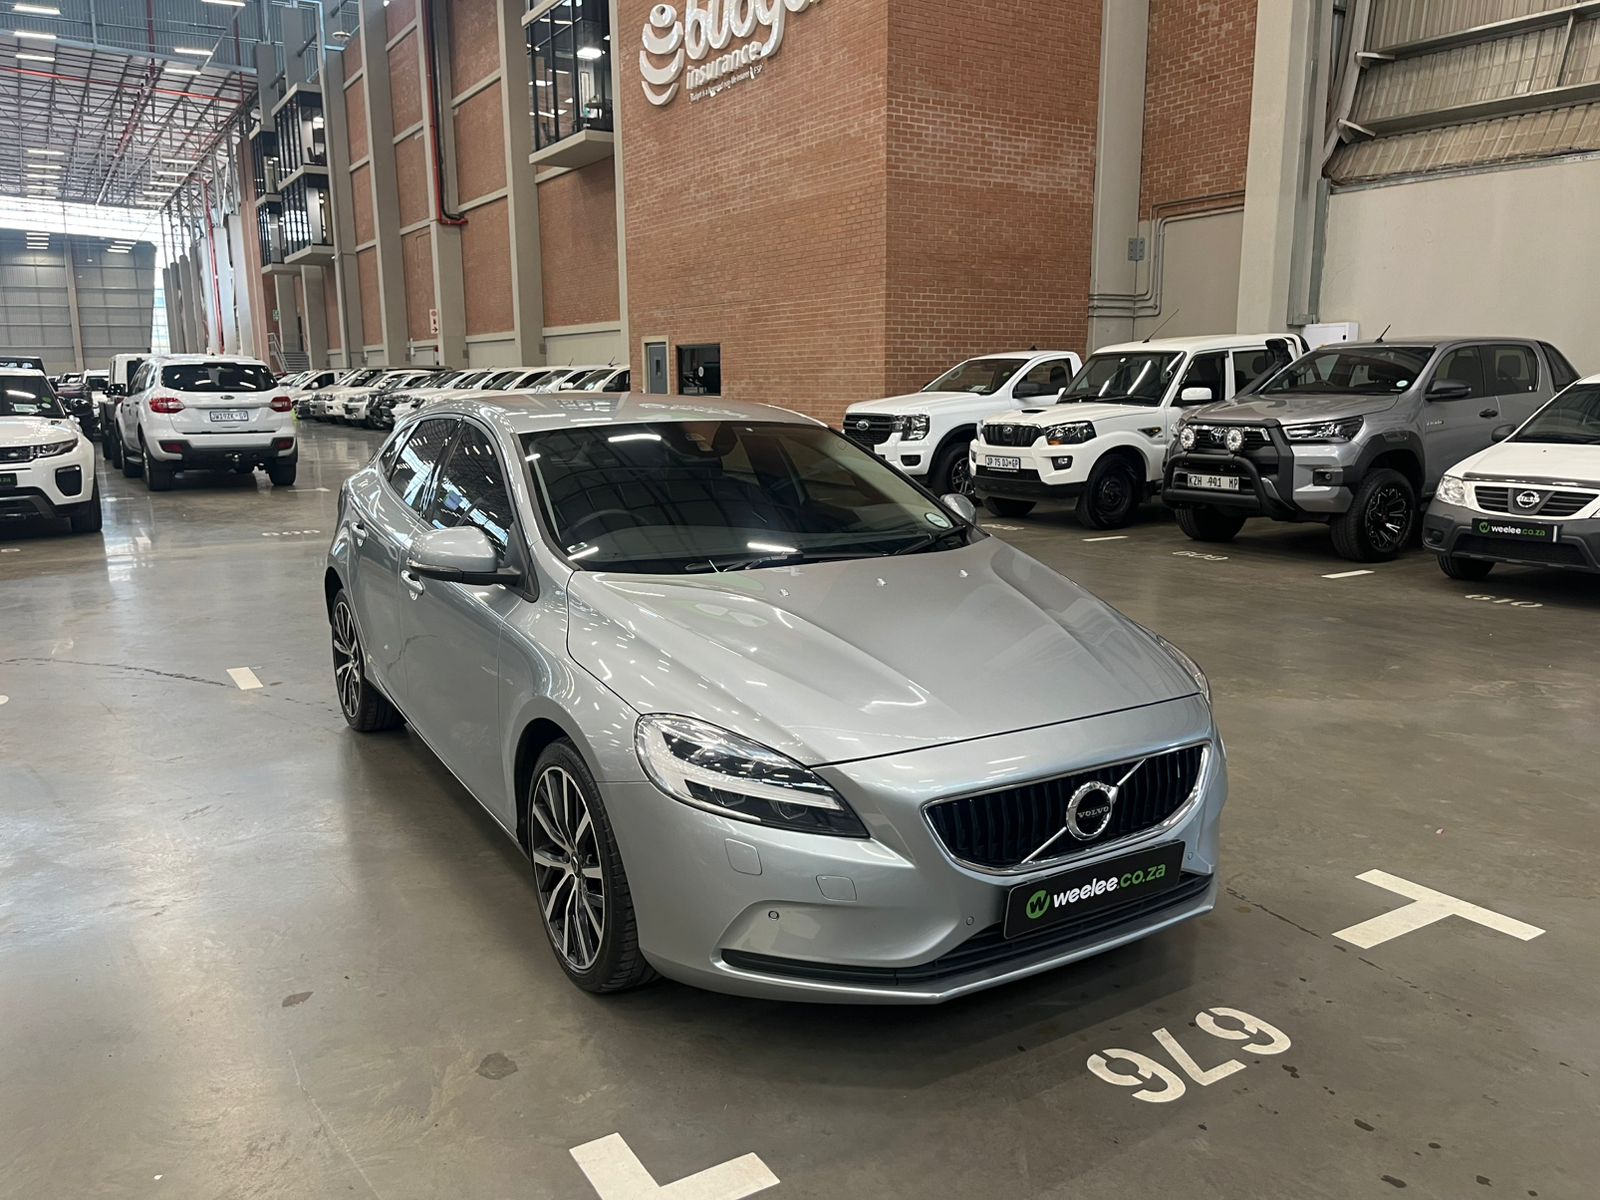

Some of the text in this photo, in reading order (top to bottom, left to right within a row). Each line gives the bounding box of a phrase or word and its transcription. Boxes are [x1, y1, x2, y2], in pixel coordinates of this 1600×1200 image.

[686, 41, 762, 90] insurance
[1189, 475, 1203, 486] KZH
[1228, 478, 1238, 488] MP
[1491, 525, 1546, 536] weelee.co.za
[1077, 806, 1109, 818] VOLVO
[1053, 863, 1166, 908] weelee.co.za
